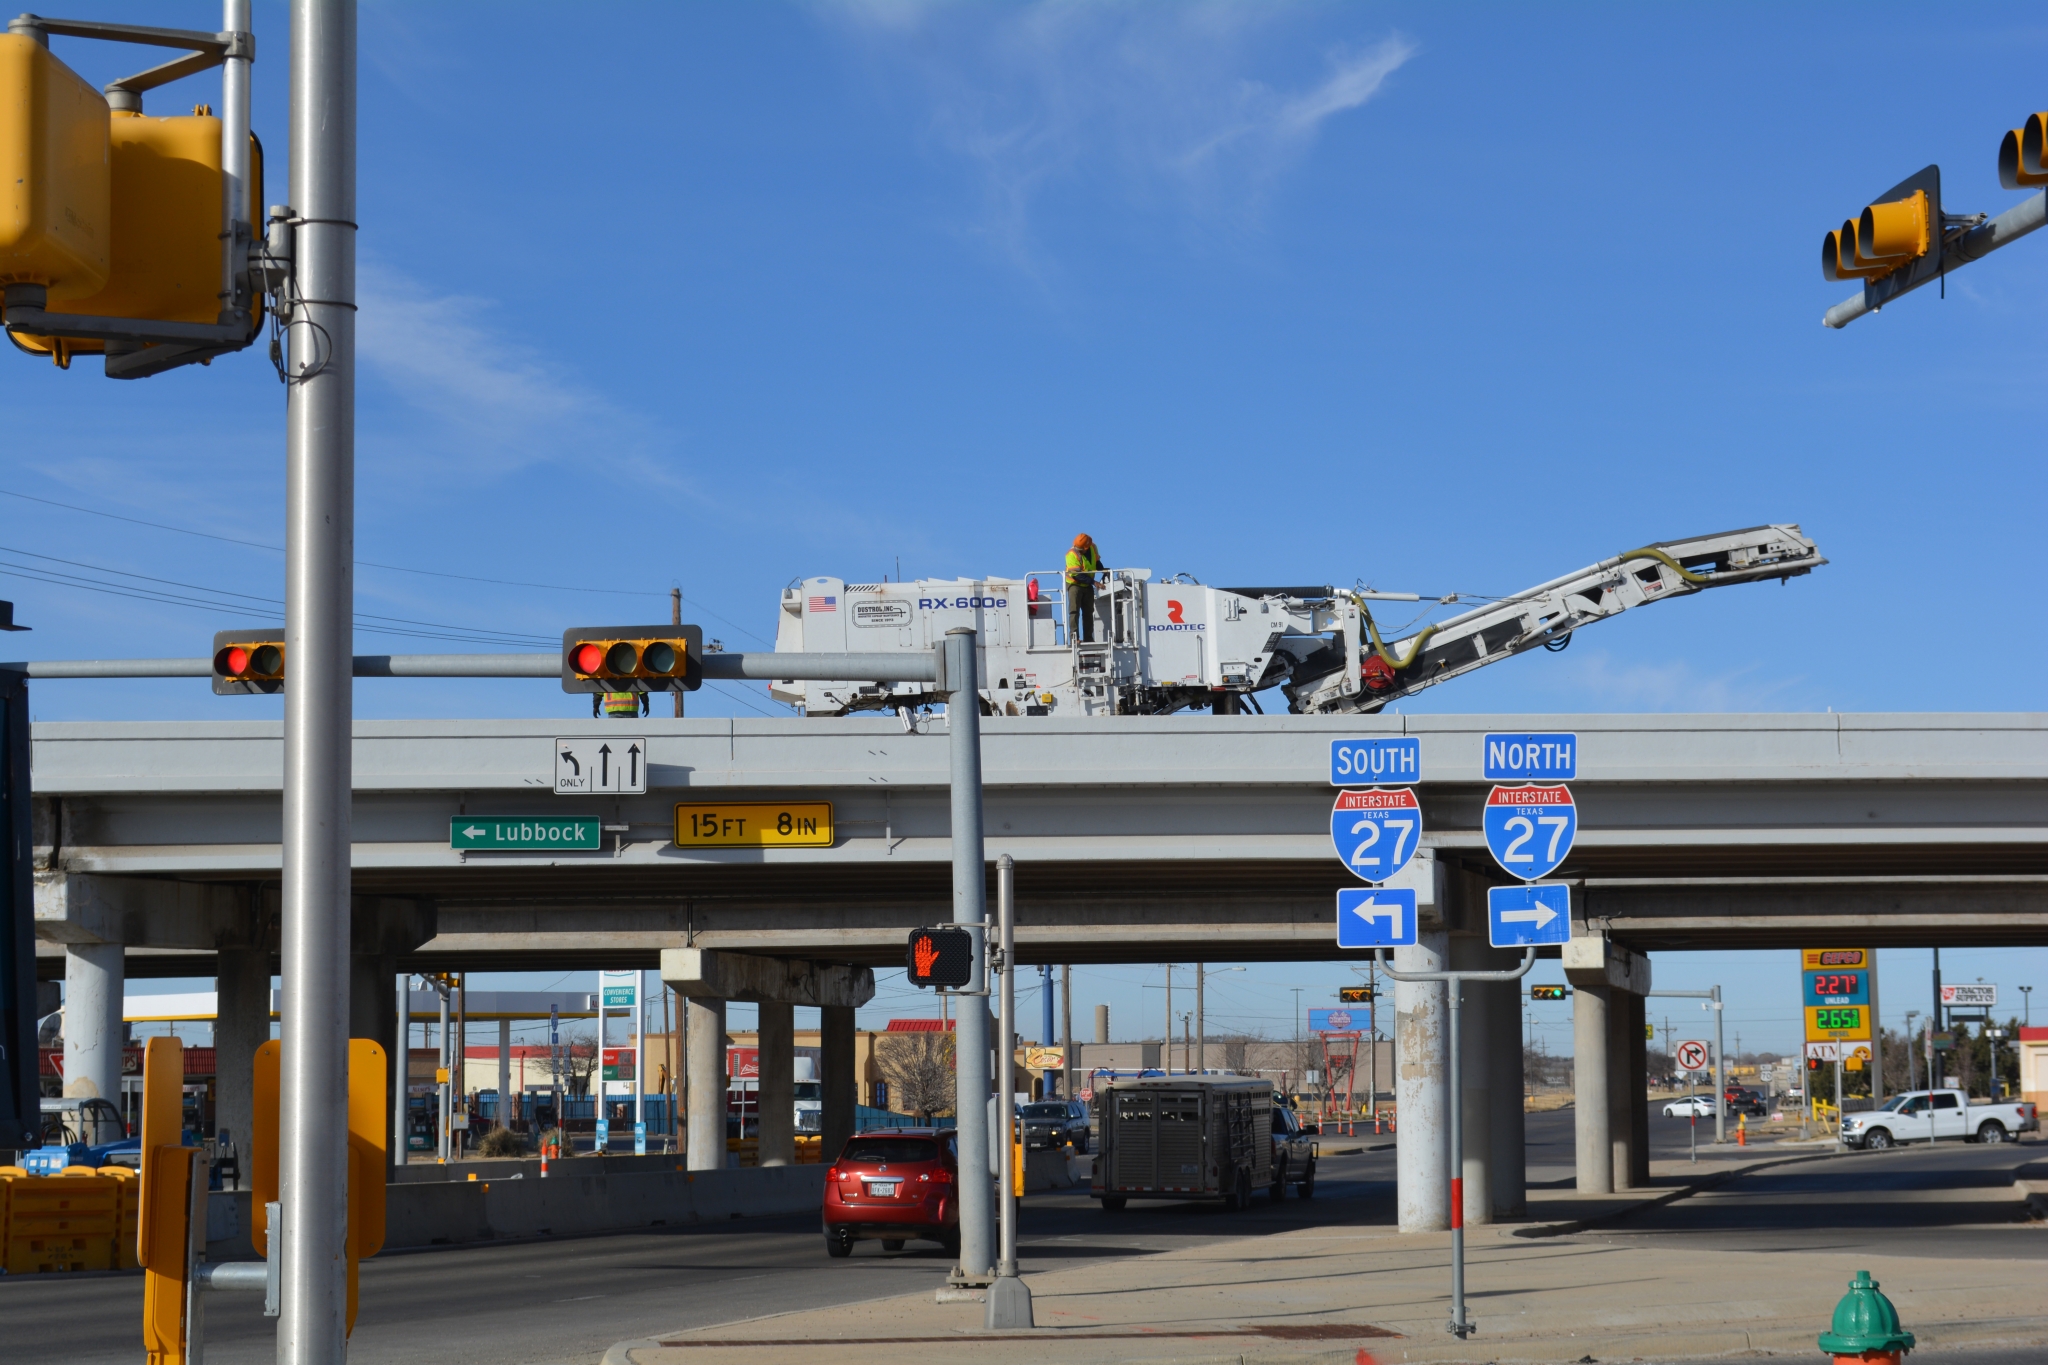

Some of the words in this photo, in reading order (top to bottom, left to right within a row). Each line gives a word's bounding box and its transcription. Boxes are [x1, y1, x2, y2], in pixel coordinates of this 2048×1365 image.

[919, 597, 1007, 610] RX-600e
[1148, 624, 1206, 632] ROADTEC
[1337, 747, 1415, 775] SOUTH
[1489, 741, 1571, 770] NORTH
[560, 778, 584, 788] ONLY
[1345, 795, 1407, 808] INTERSTATE
[1498, 791, 1562, 804] INTERSTATE
[1363, 811, 1389, 819] TEXAS
[1516, 808, 1543, 816] TEXAS
[495, 823, 586, 841] Lubbock
[1350, 819, 1414, 866] 27
[1503, 816, 1569, 863] 27
[604, 988, 634, 996] CONVENIENCE
[1956, 987, 1994, 995] TRACTOR
[610, 996, 627, 1004] STORES
[1824, 996, 1850, 1005] UNLEAD
